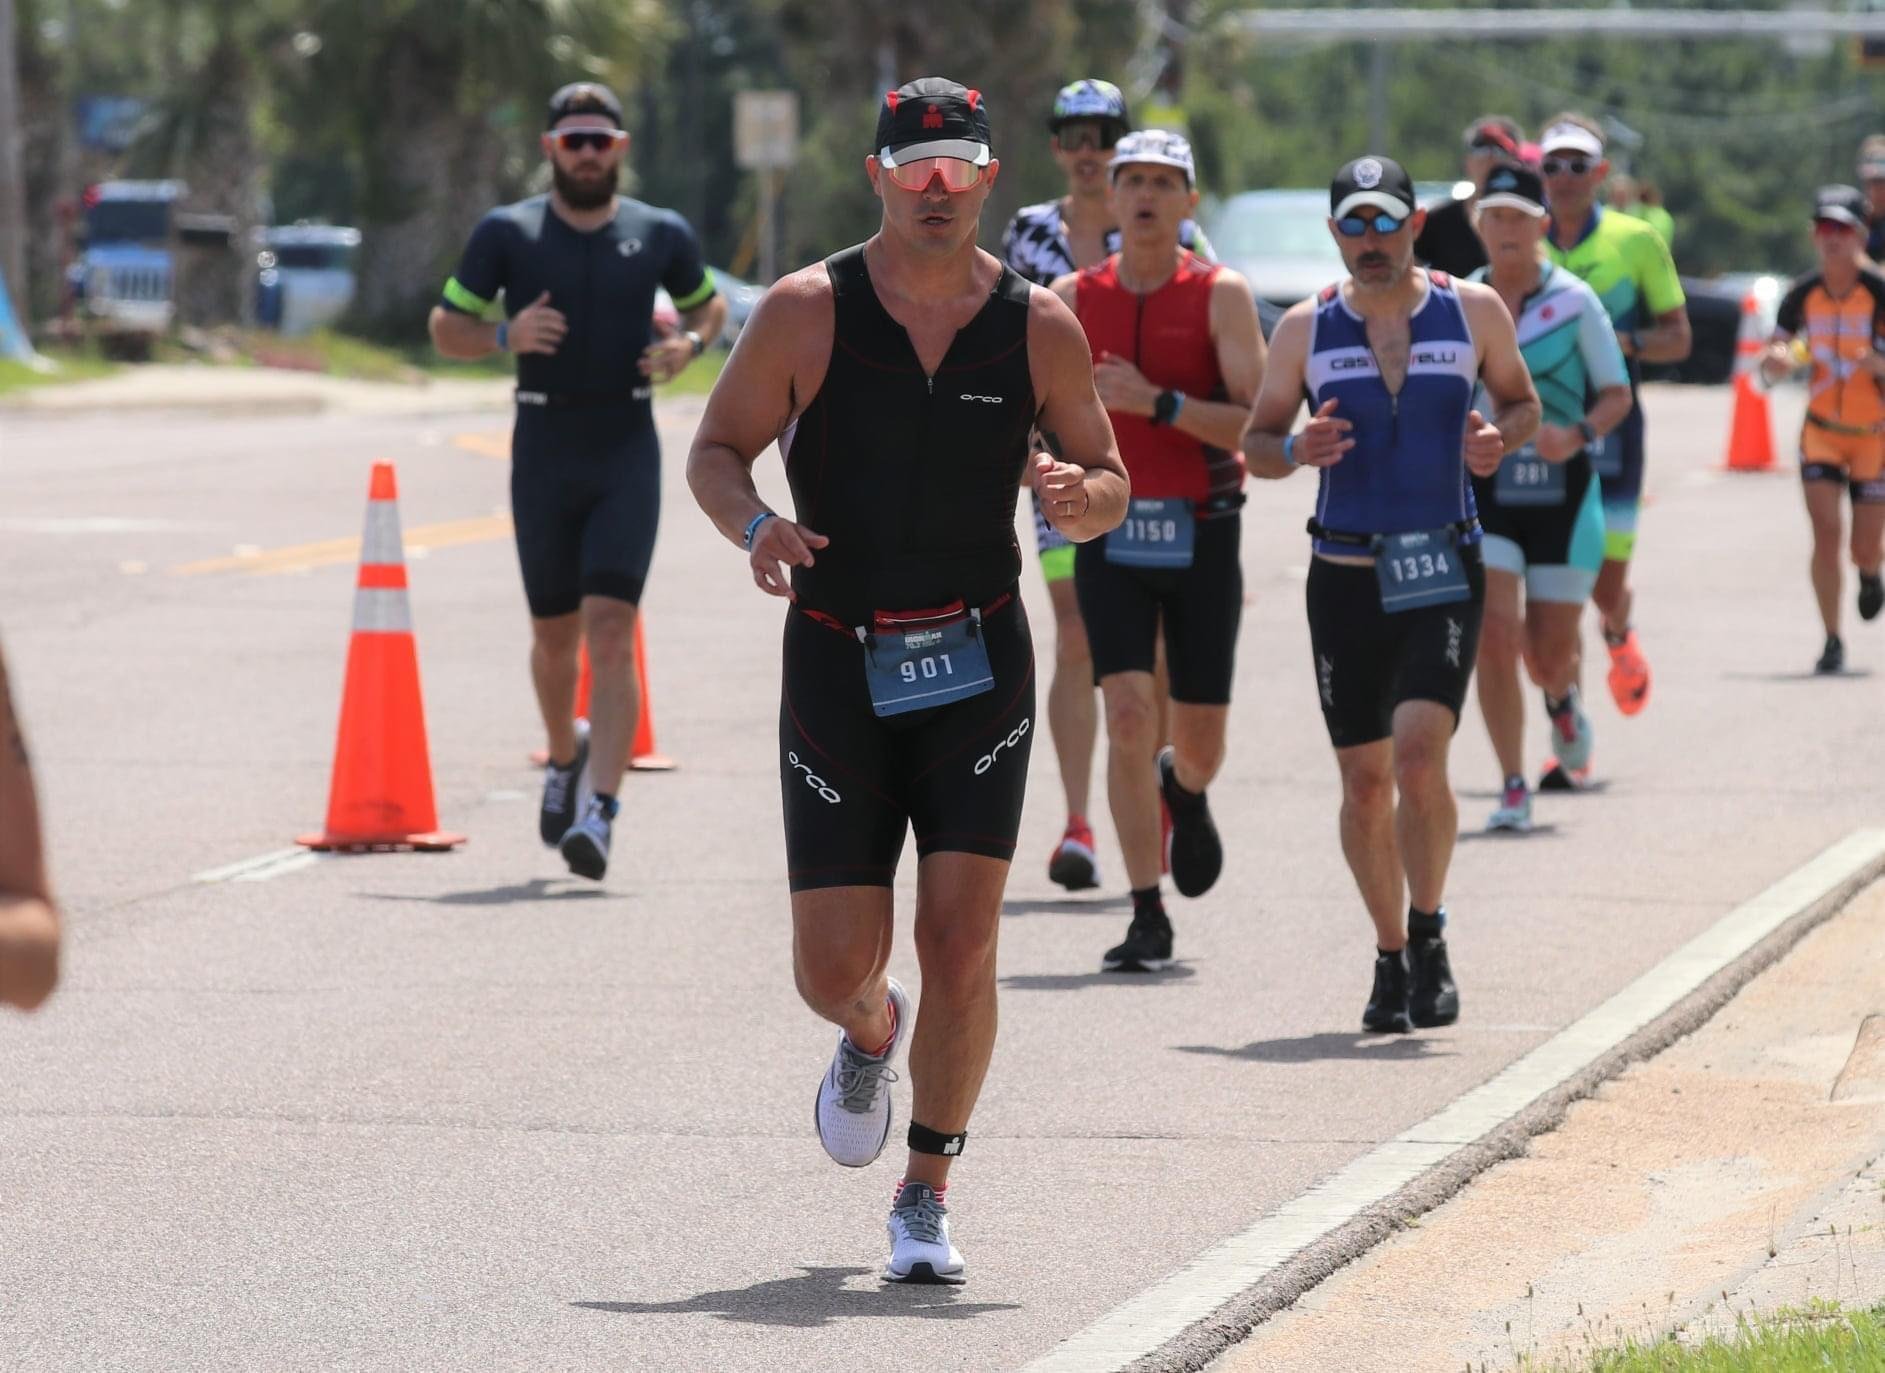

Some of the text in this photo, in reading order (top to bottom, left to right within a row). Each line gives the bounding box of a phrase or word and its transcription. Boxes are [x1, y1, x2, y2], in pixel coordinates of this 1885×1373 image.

[960, 394, 1003, 403] orca
[1126, 518, 1176, 542] 1150
[1392, 552, 1449, 582] 1334
[900, 654, 953, 683] 901
[974, 718, 1030, 776] orca
[788, 751, 842, 804] orca
